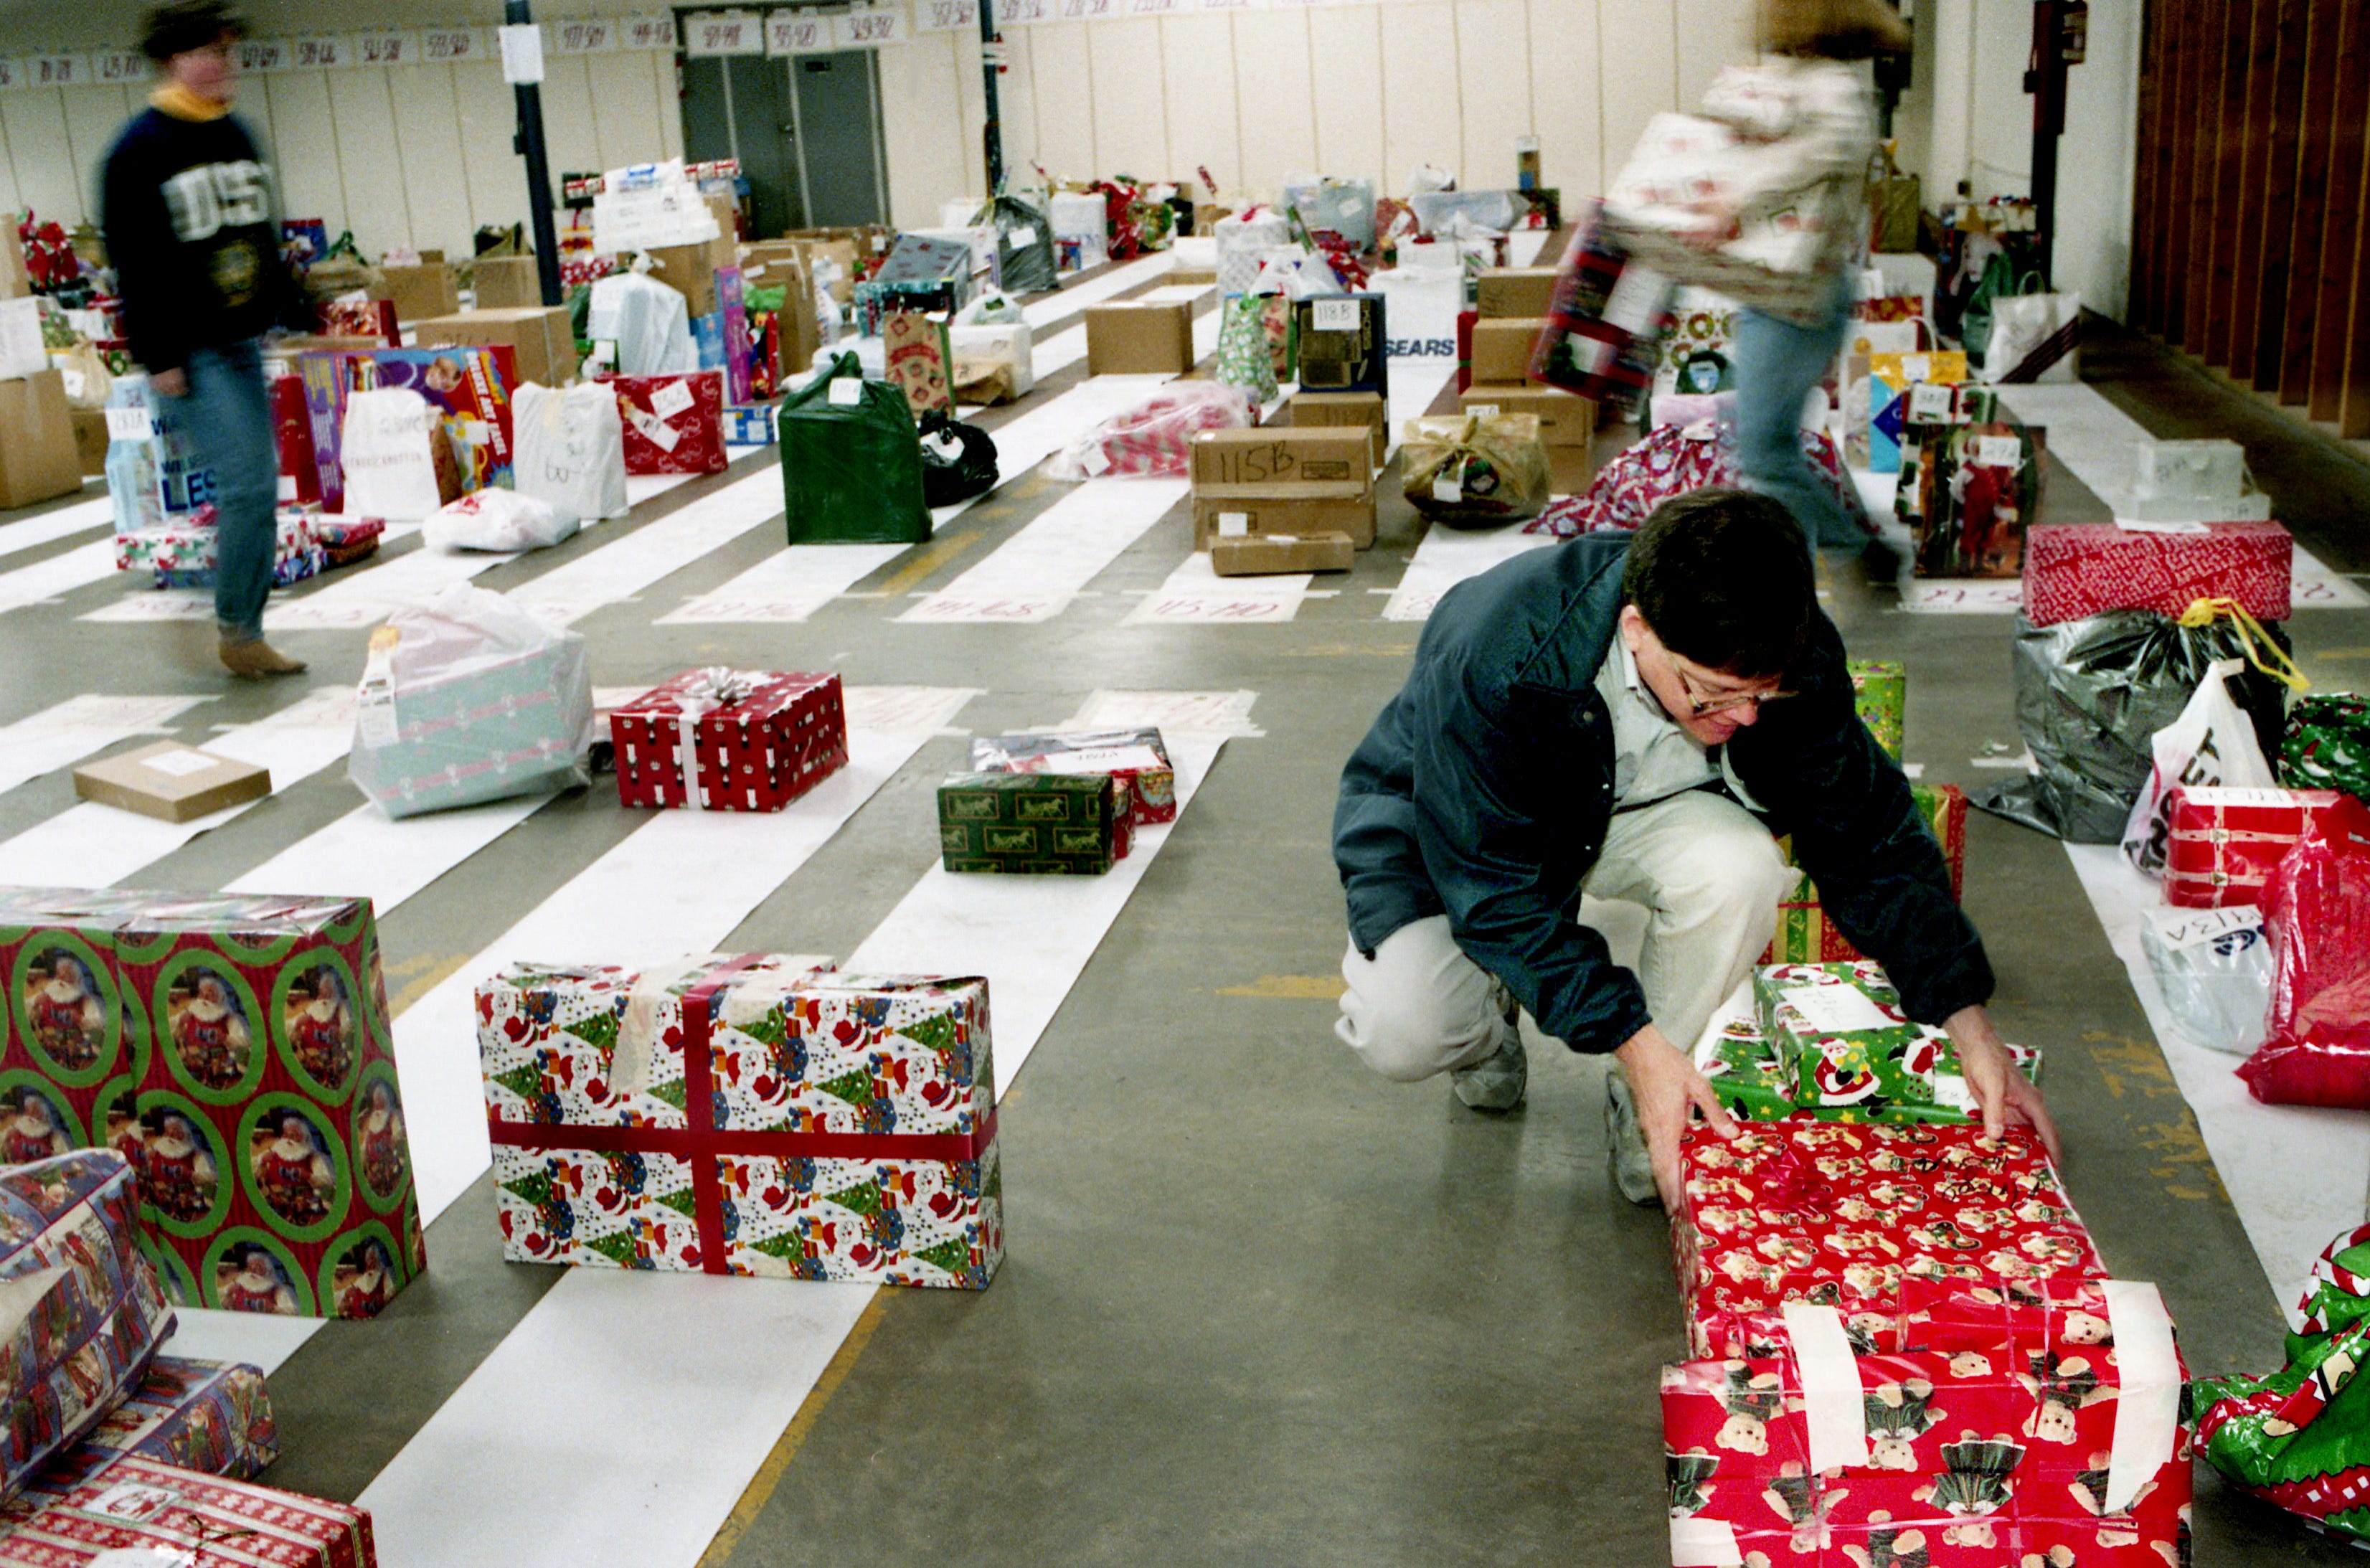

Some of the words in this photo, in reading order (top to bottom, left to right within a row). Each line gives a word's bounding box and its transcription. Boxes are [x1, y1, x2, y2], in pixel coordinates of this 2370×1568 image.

[1318, 303, 1351, 320] 118B
[1385, 339, 1455, 357] SEARS
[1220, 439, 1294, 485] 115B
